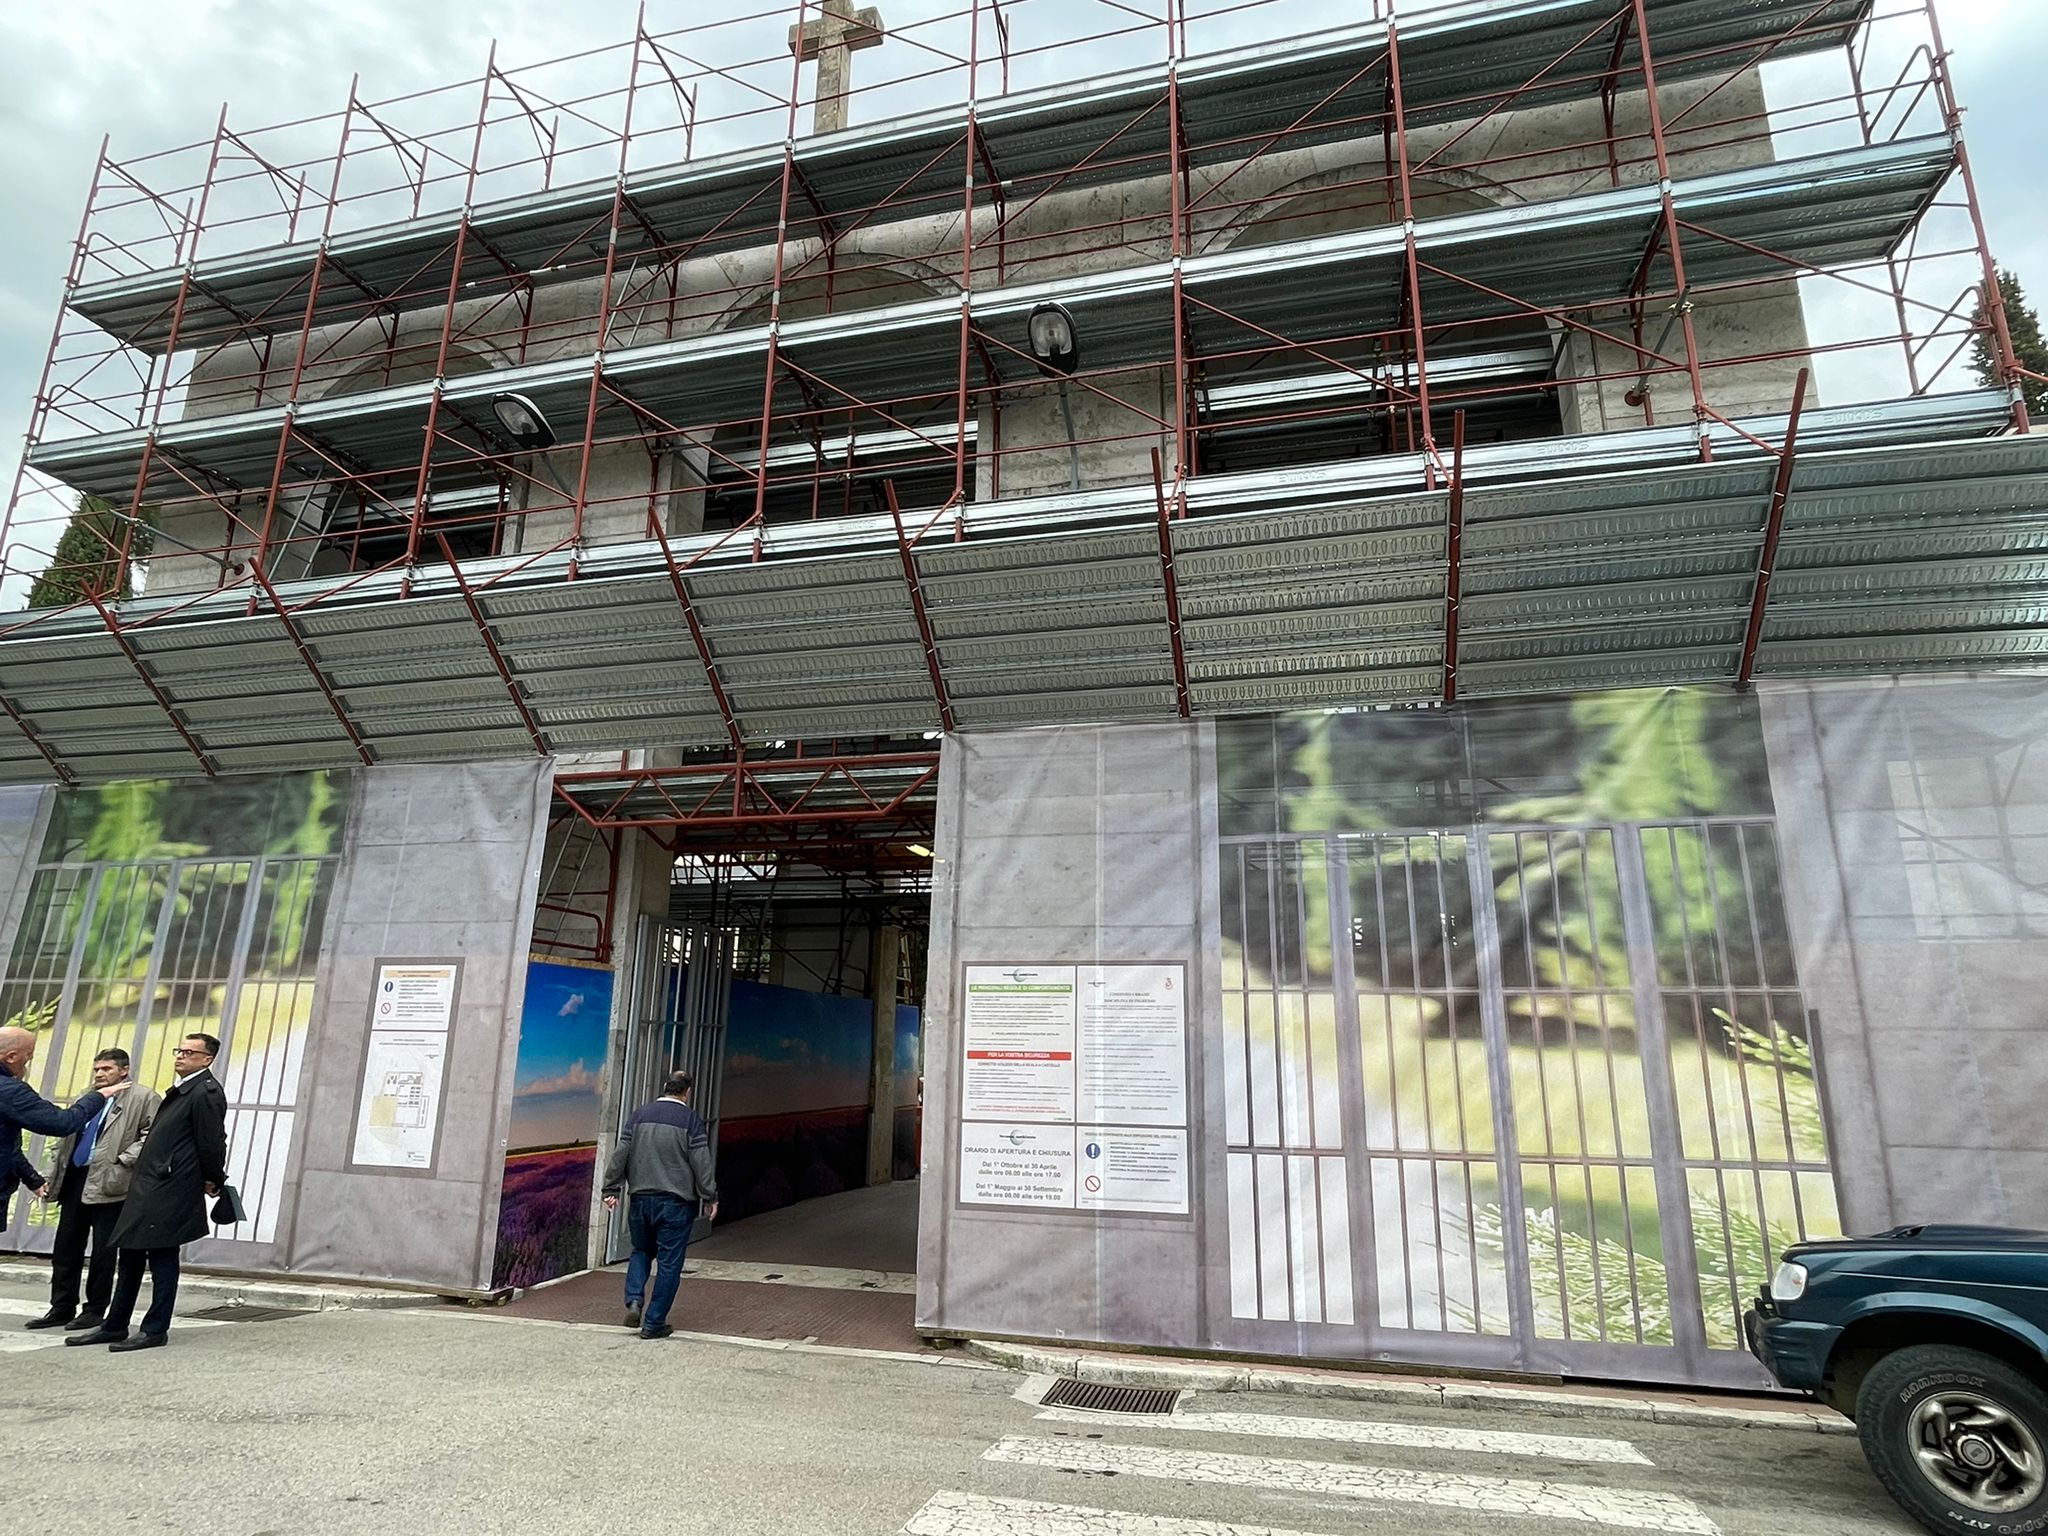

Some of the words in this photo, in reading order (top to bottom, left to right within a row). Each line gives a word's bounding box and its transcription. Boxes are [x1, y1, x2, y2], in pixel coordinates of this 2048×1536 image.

[964, 1146, 989, 1154] ORARIO
[1000, 1161, 1023, 1169] Ottobre
[994, 1183, 1016, 1191] Maggio
